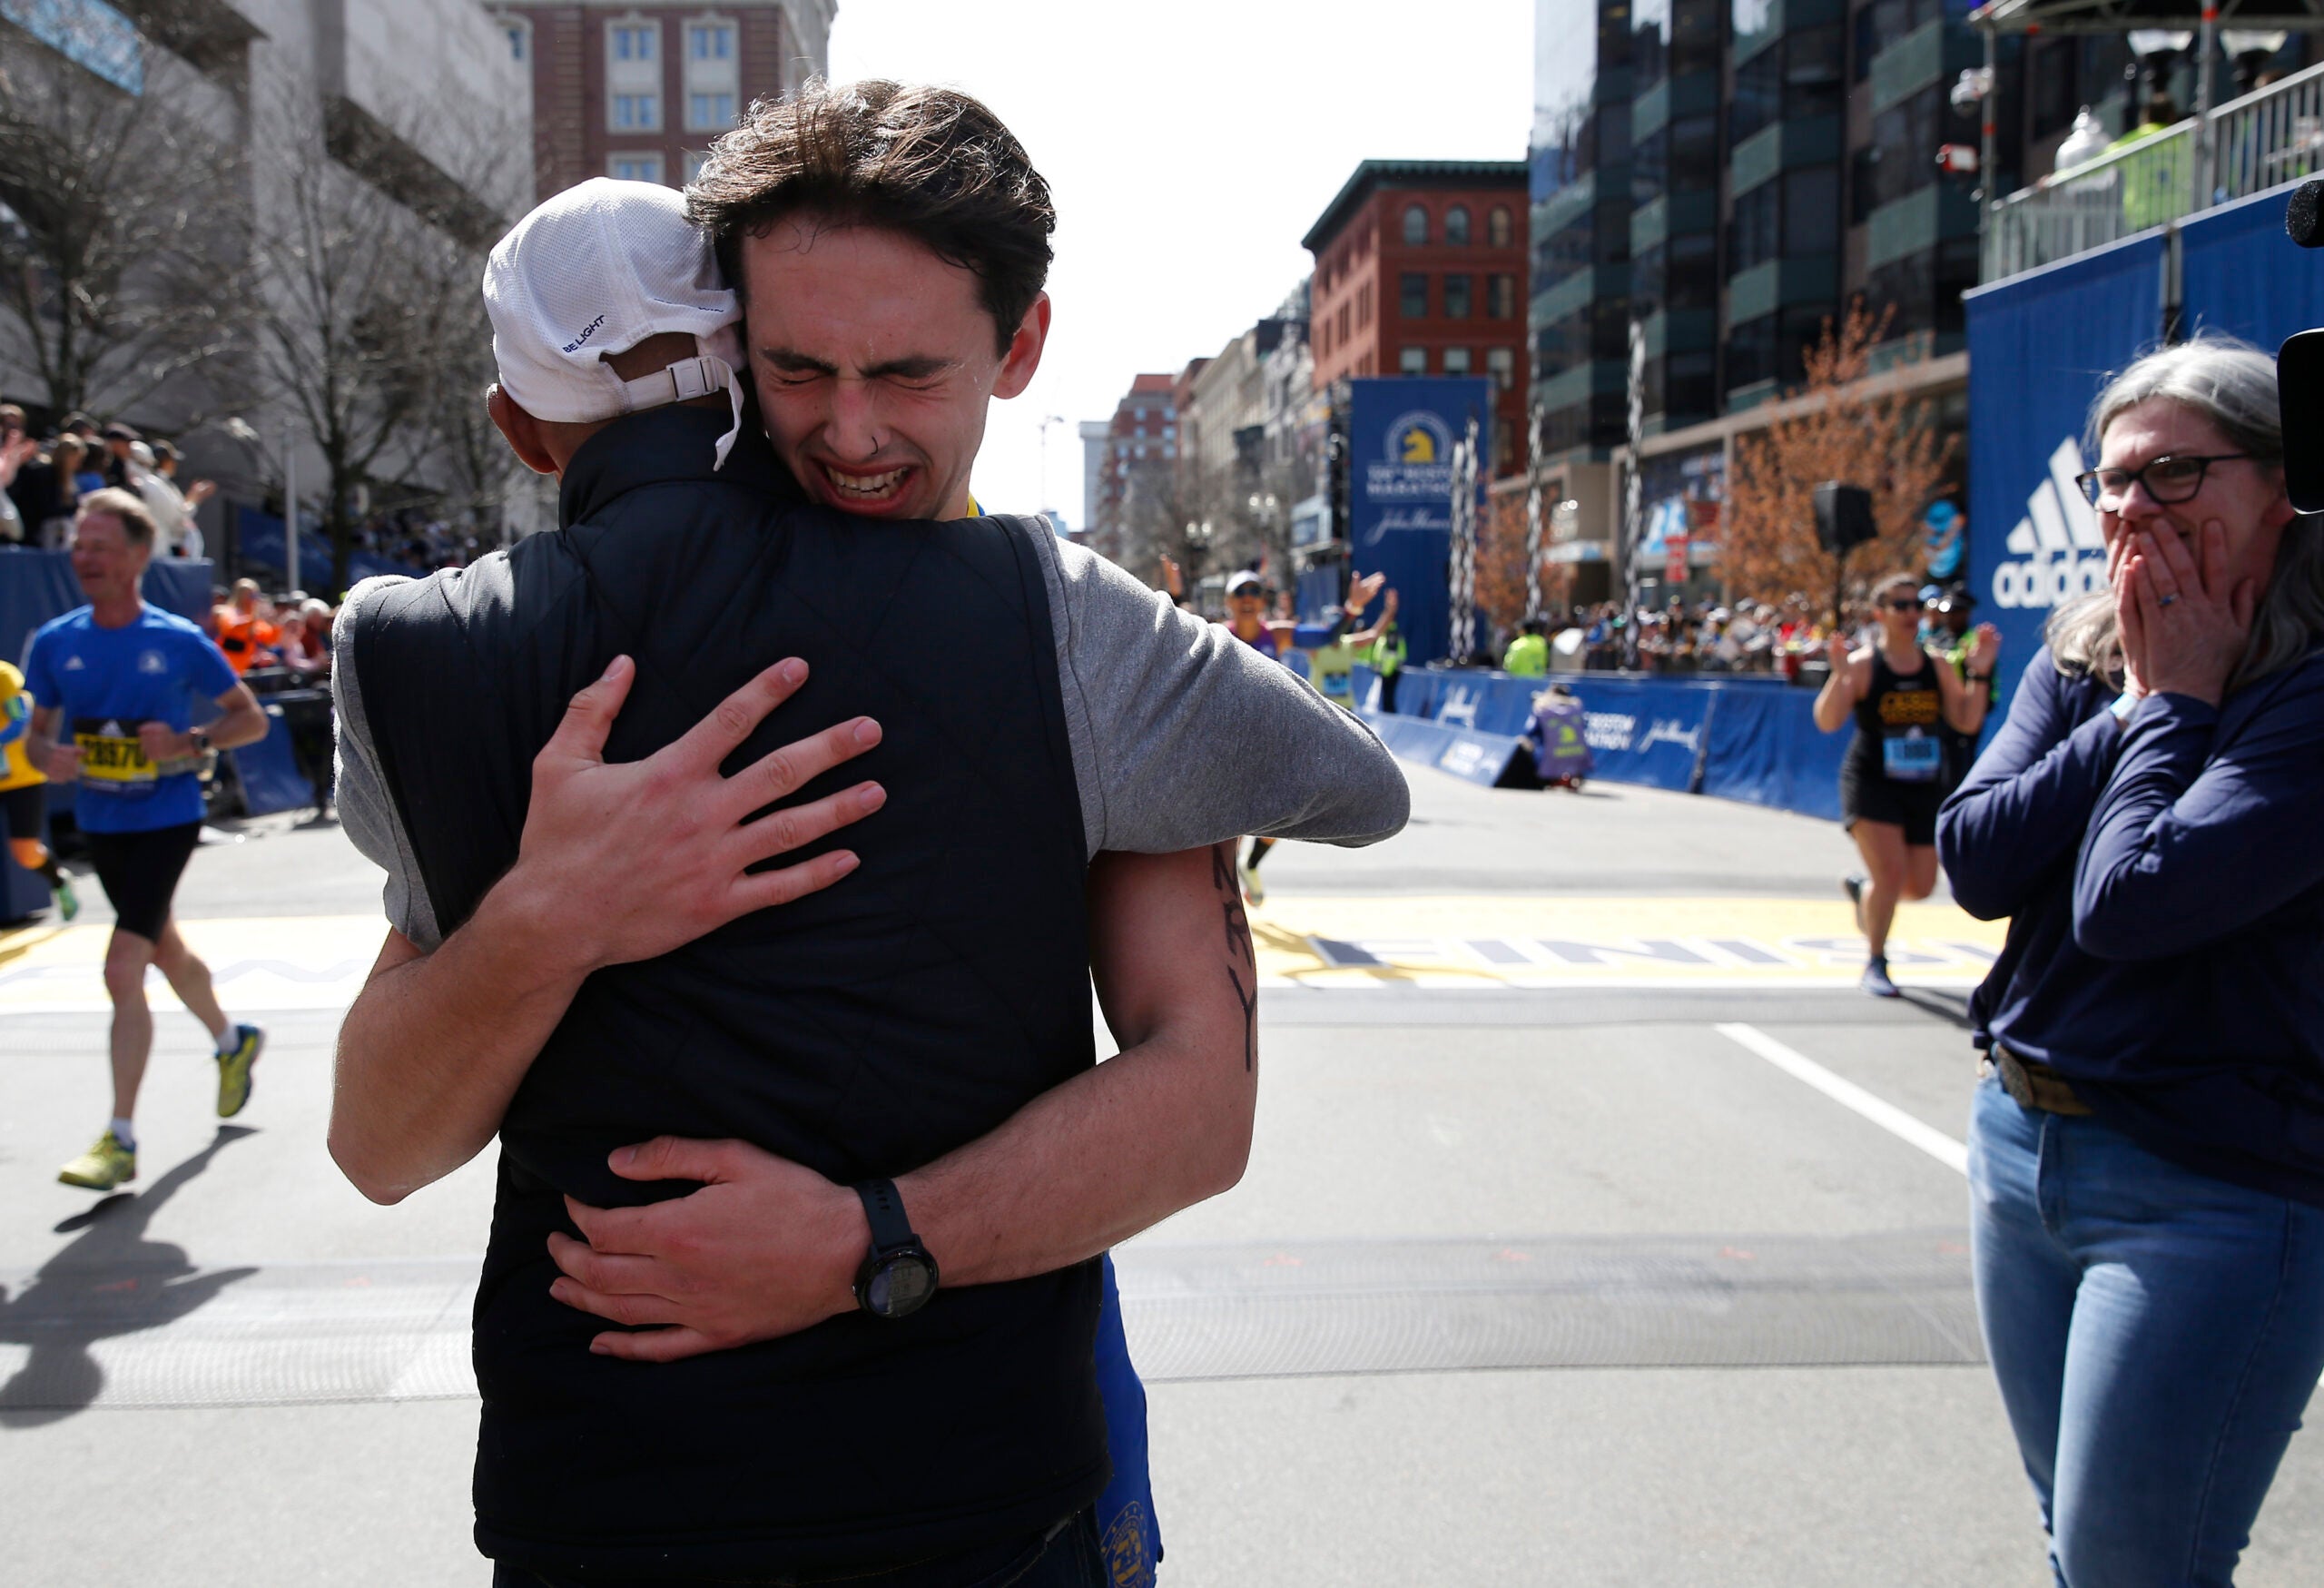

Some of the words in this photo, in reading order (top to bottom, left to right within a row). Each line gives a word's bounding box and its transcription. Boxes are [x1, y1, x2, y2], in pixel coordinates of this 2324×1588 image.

[562, 342, 579, 353] BE
[575, 314, 606, 346] LIGHT
[1992, 543, 2112, 609] adida
